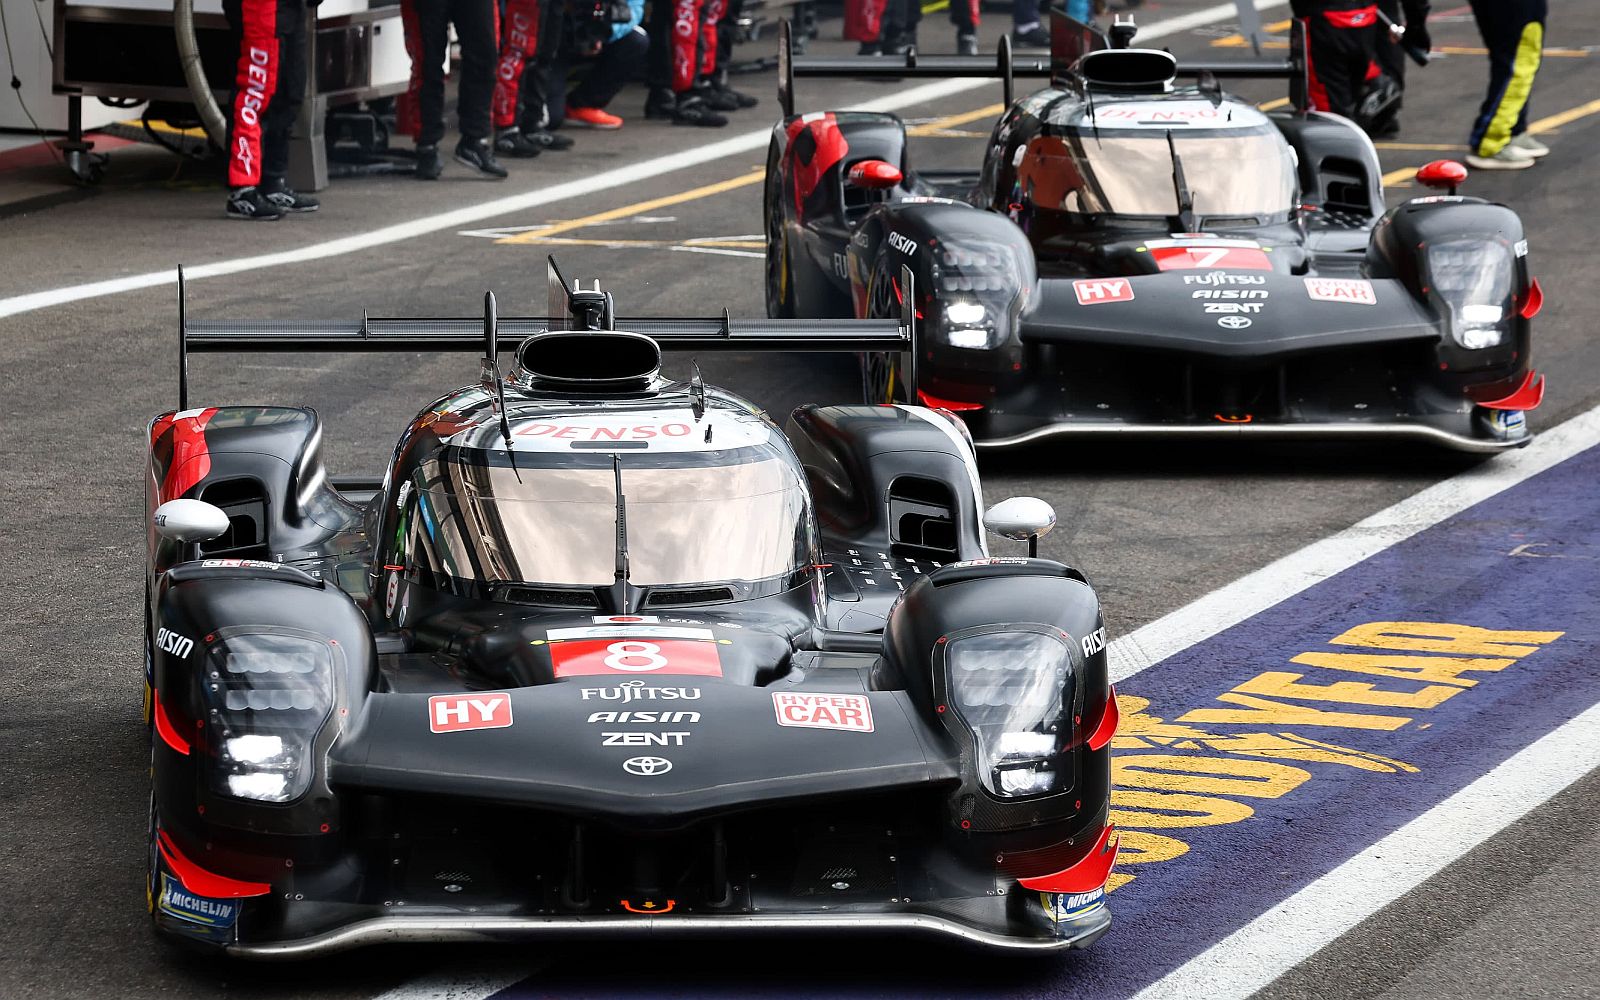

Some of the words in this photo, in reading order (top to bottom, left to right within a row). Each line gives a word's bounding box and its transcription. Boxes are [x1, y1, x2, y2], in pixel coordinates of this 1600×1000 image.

[240, 47, 269, 126] DENSO
[888, 231, 917, 256] AISIN
[1186, 247, 1230, 268] 7
[1183, 270, 1266, 286] FUJITSU
[1078, 281, 1125, 300] HY
[1191, 289, 1269, 299] AISIN
[1315, 287, 1369, 300] CAR
[1203, 302, 1264, 314] ZENT
[514, 423, 692, 440] DENSO
[156, 627, 194, 660] AISIN
[603, 641, 669, 672] 8
[580, 680, 701, 703] FUJITSU
[435, 697, 502, 726] HY
[781, 695, 861, 709] HYPER
[587, 711, 702, 723] AISIN
[784, 704, 865, 727] CAR
[601, 731, 691, 746] ZENT
[171, 891, 232, 918] MICHELIN
